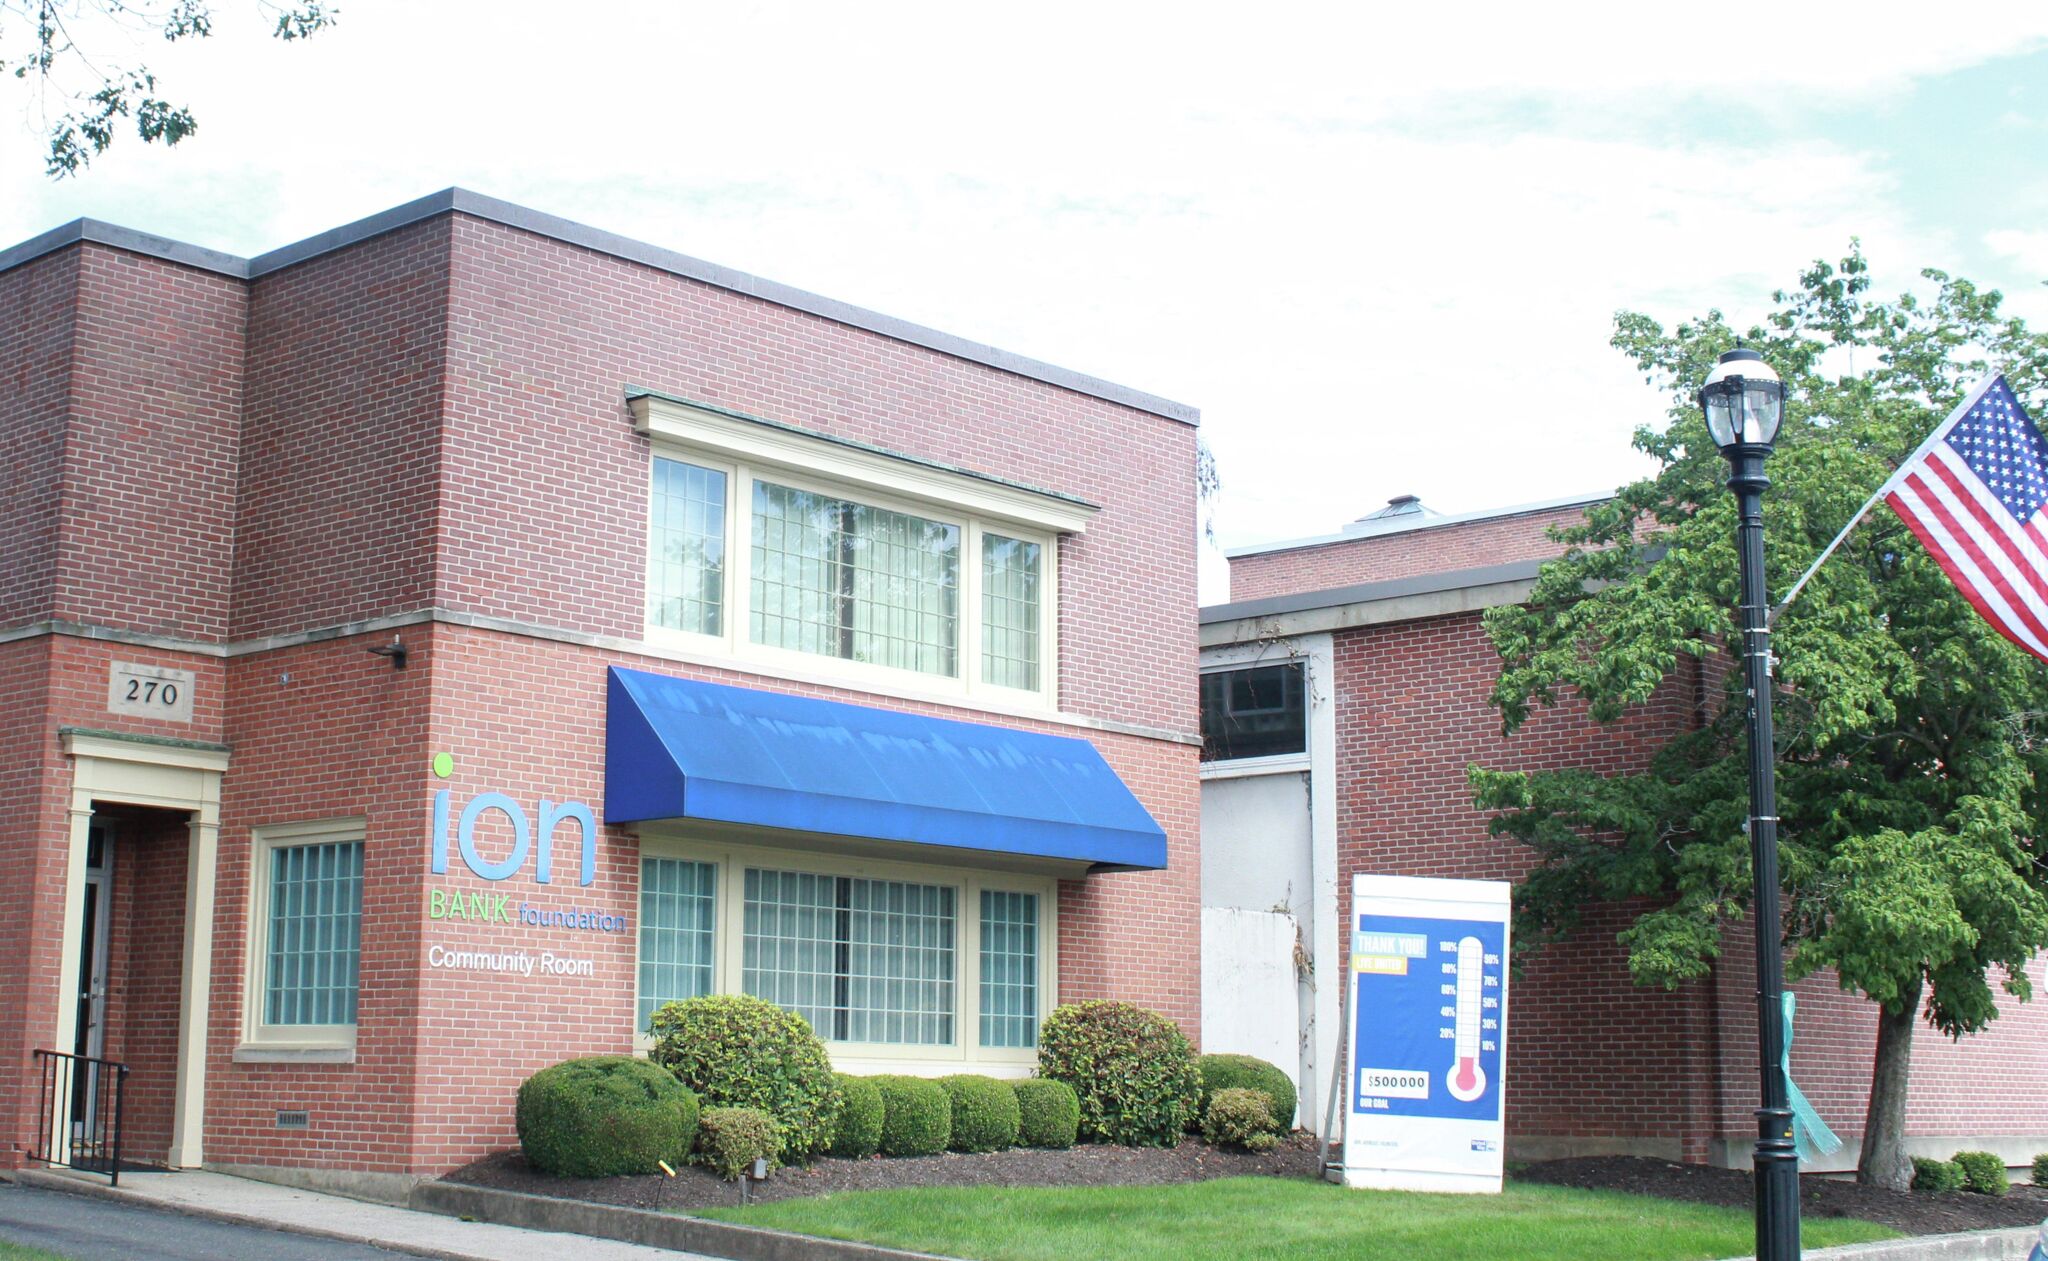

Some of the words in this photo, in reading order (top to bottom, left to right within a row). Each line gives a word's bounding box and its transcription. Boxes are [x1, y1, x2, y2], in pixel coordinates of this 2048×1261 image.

[126, 679, 178, 705] 270
[431, 751, 596, 887] ion
[430, 888, 511, 923] BANK
[519, 902, 627, 932] foundation
[1358, 934, 1396, 954] THANK
[1400, 937, 1425, 956] YOU!
[1439, 941, 1458, 953] 100%
[428, 945, 535, 977] Community
[540, 952, 594, 976] Room
[1357, 957, 1373, 968] LIVE
[1484, 954, 1499, 965] 90%
[1441, 963, 1457, 975] 80%
[1484, 976, 1498, 987] 70%
[1482, 997, 1498, 1008] 50%
[1440, 1006, 1456, 1018] 40%
[1482, 1019, 1497, 1030] 30%
[1439, 1028, 1455, 1039] 20%
[1482, 1040, 1495, 1051] 10%
[1369, 1076, 1425, 1088] $500000
[1360, 1098, 1372, 1108] OUR
[1374, 1098, 1389, 1109] GOAL
